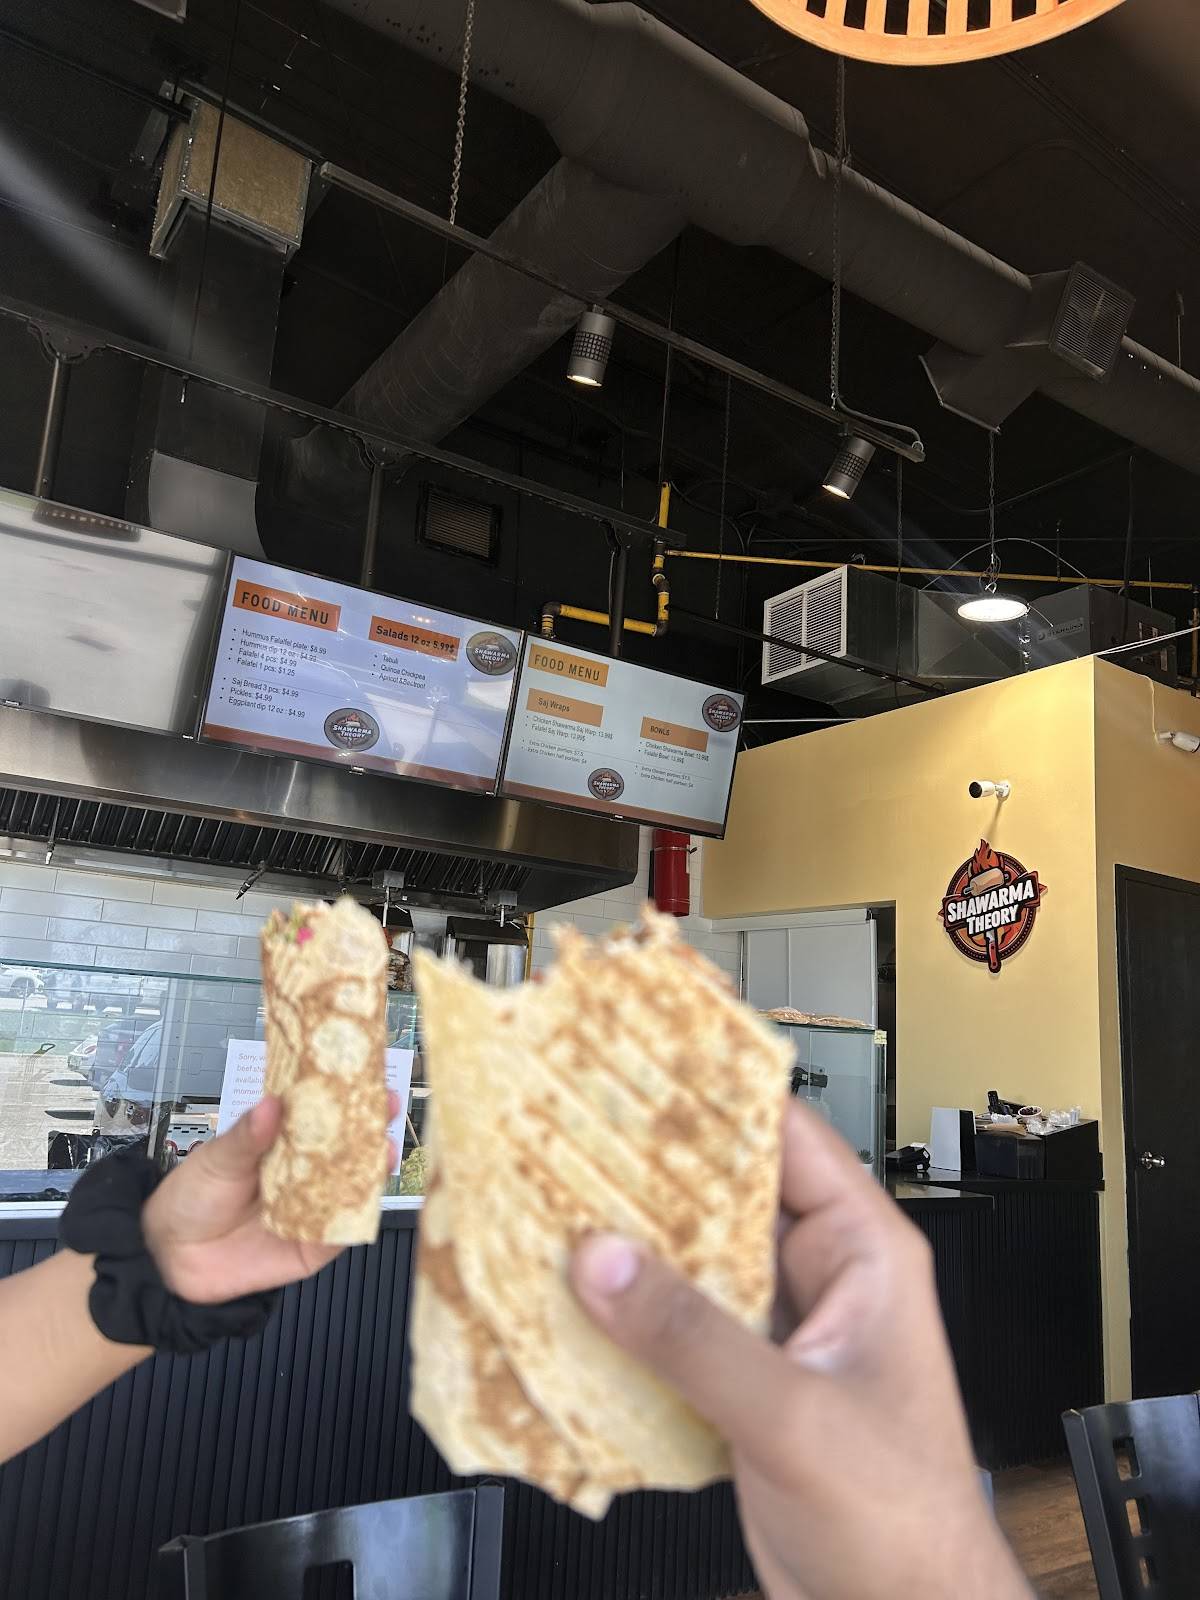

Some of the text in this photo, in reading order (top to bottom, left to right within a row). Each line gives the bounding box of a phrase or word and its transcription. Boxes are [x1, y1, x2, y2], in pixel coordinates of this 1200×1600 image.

[242, 592, 328, 624] FOOD MENU
[376, 626, 408, 642] Salads
[411, 634, 419, 644] 12
[433, 640, 455, 654] 5.99$
[534, 654, 600, 681] FOOD MENU
[243, 680, 262, 690] Bread
[255, 692, 272, 702] $4.99
[538, 696, 570, 712] Saj Wraps
[333, 724, 372, 735] SHAWARMA
[650, 725, 670, 736] BOWLS
[948, 880, 1034, 922] SHAWARMA
[966, 904, 1018, 935] THEORY
